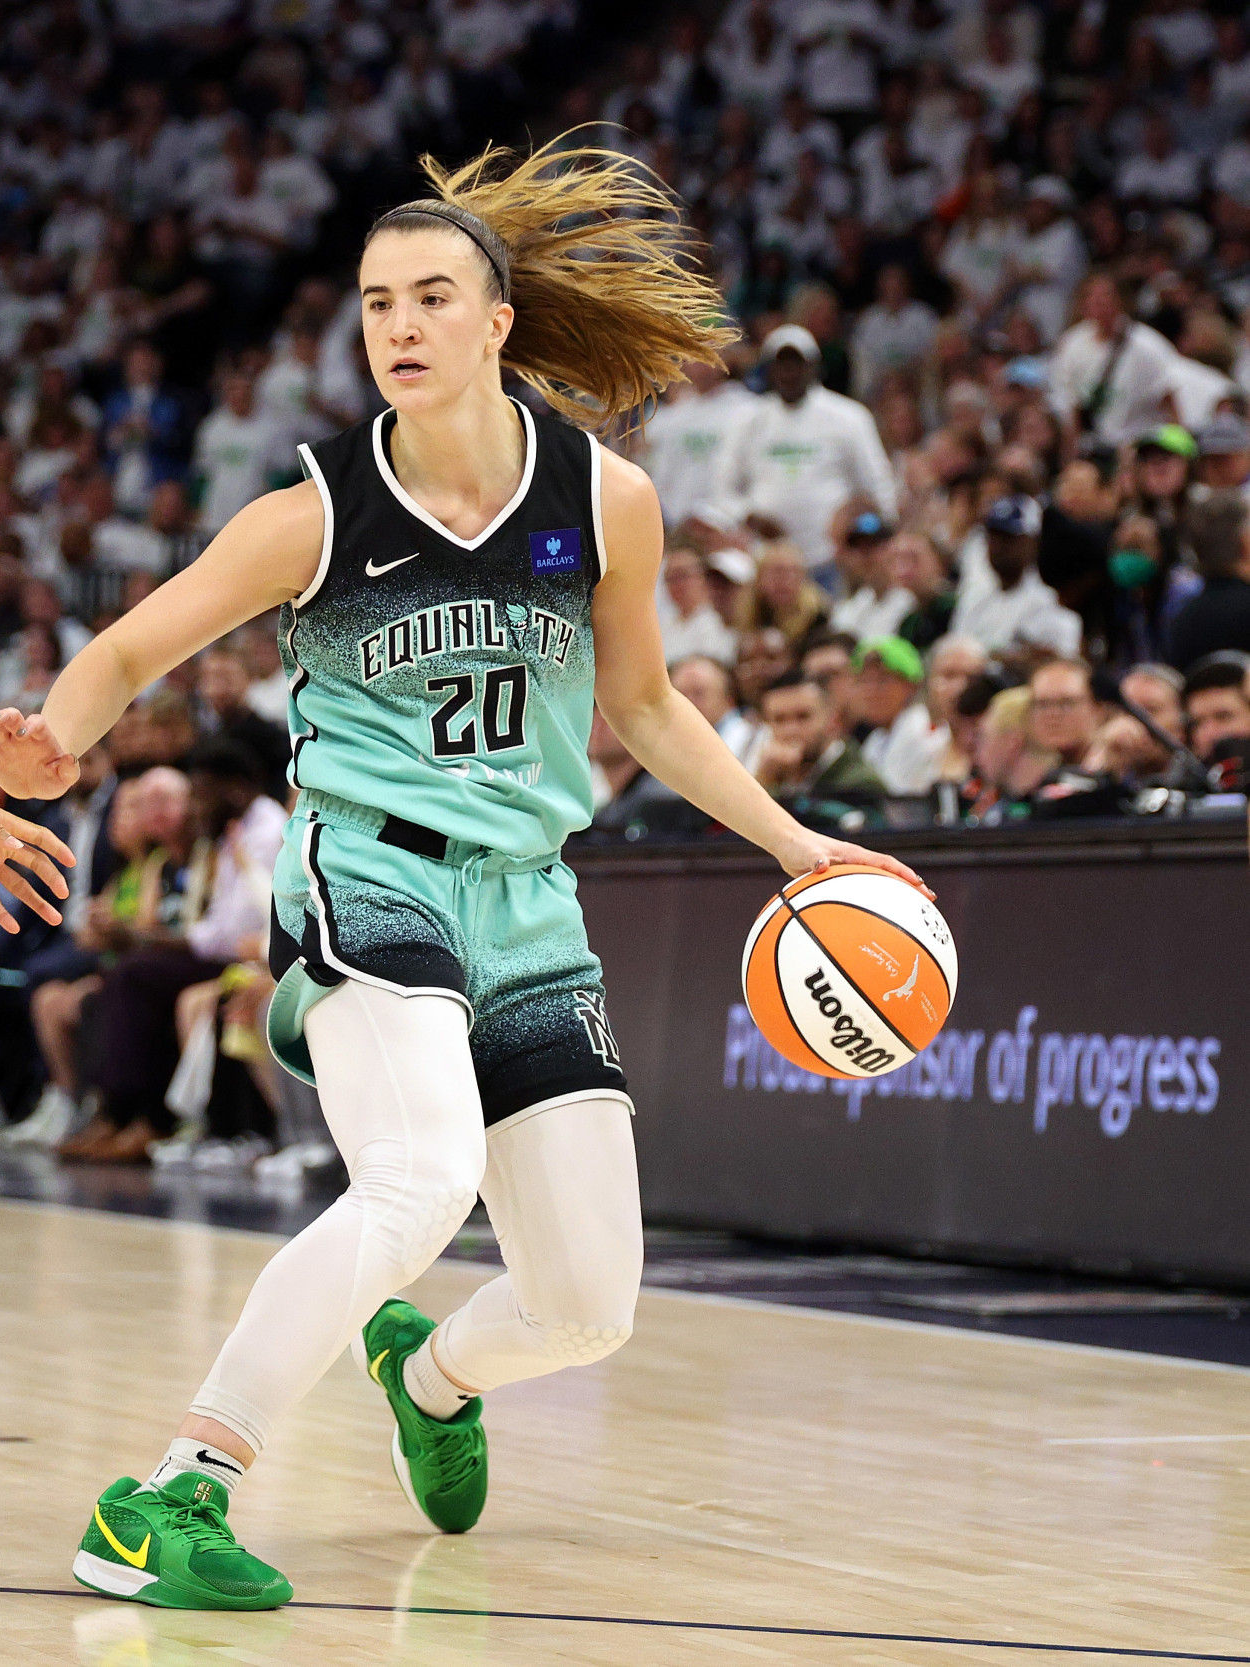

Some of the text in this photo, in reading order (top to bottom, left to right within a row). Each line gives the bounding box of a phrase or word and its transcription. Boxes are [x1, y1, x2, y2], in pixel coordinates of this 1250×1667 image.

[536, 555, 575, 568] BARCLAYS
[425, 663, 528, 758] 20
[804, 966, 896, 1073] Wilson
[987, 1004, 1038, 1104] of
[1033, 1032, 1222, 1138] progress
